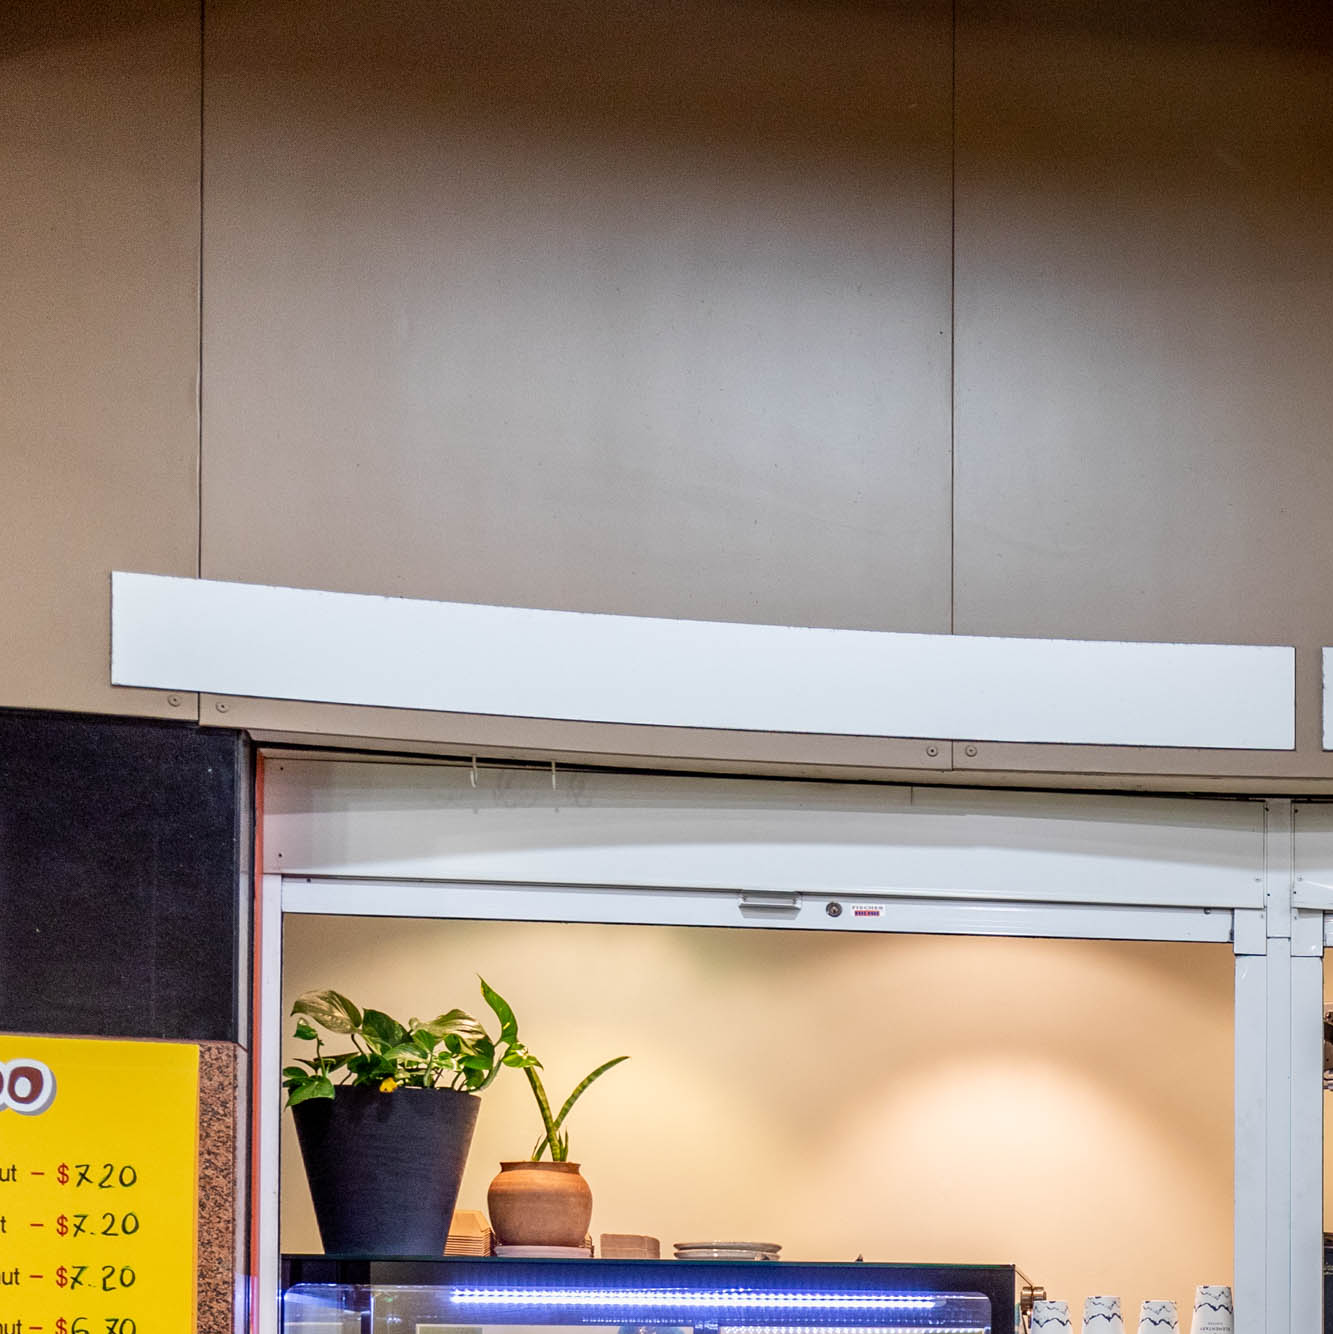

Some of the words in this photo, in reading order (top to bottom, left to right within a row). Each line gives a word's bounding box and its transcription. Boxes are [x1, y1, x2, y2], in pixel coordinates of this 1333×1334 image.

[56, 1213, 139, 1237] $7.20
[0, 1267, 20, 1286] ut
[56, 1265, 136, 1291] $7.20
